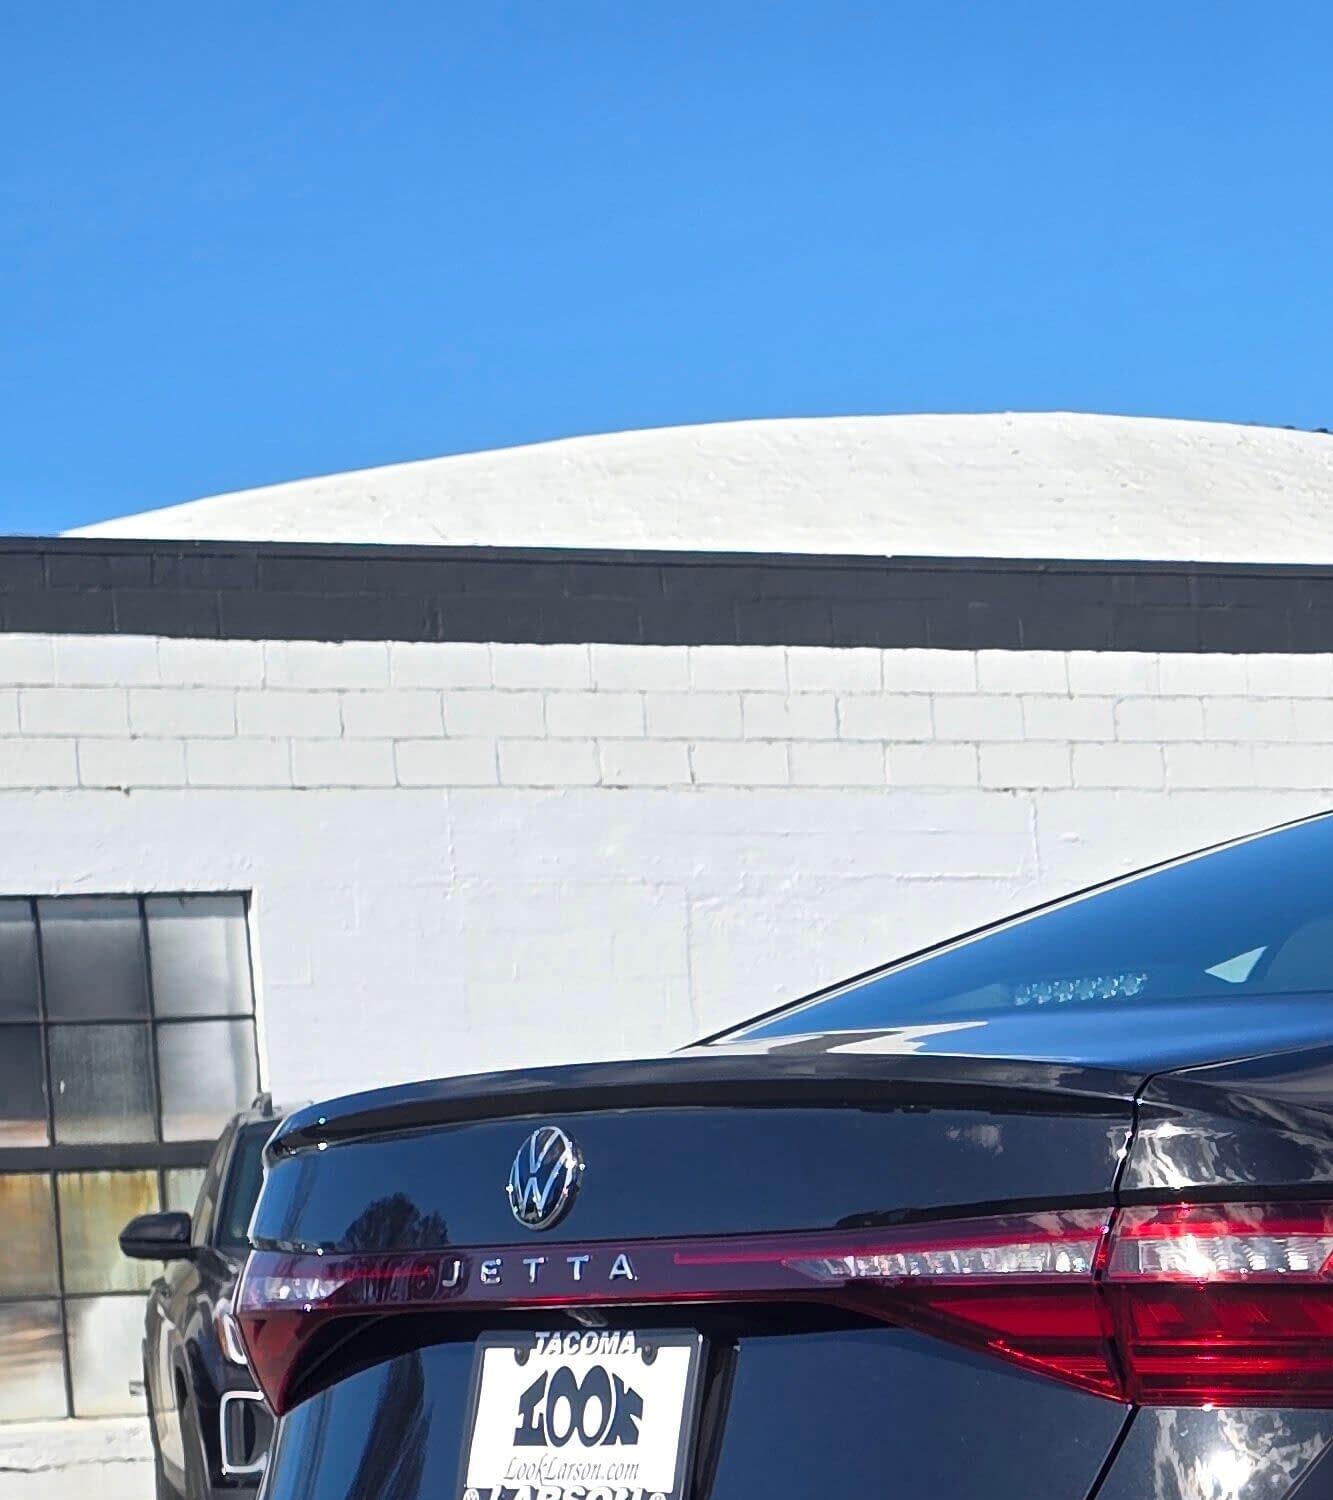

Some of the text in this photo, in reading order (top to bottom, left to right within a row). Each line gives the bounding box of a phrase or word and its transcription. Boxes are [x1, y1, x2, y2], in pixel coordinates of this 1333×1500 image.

[442, 1253, 635, 1287] JETTA
[535, 1331, 637, 1355] TACOMA
[513, 1366, 644, 1447] LOOK
[503, 1453, 640, 1486] LookLarson.com
